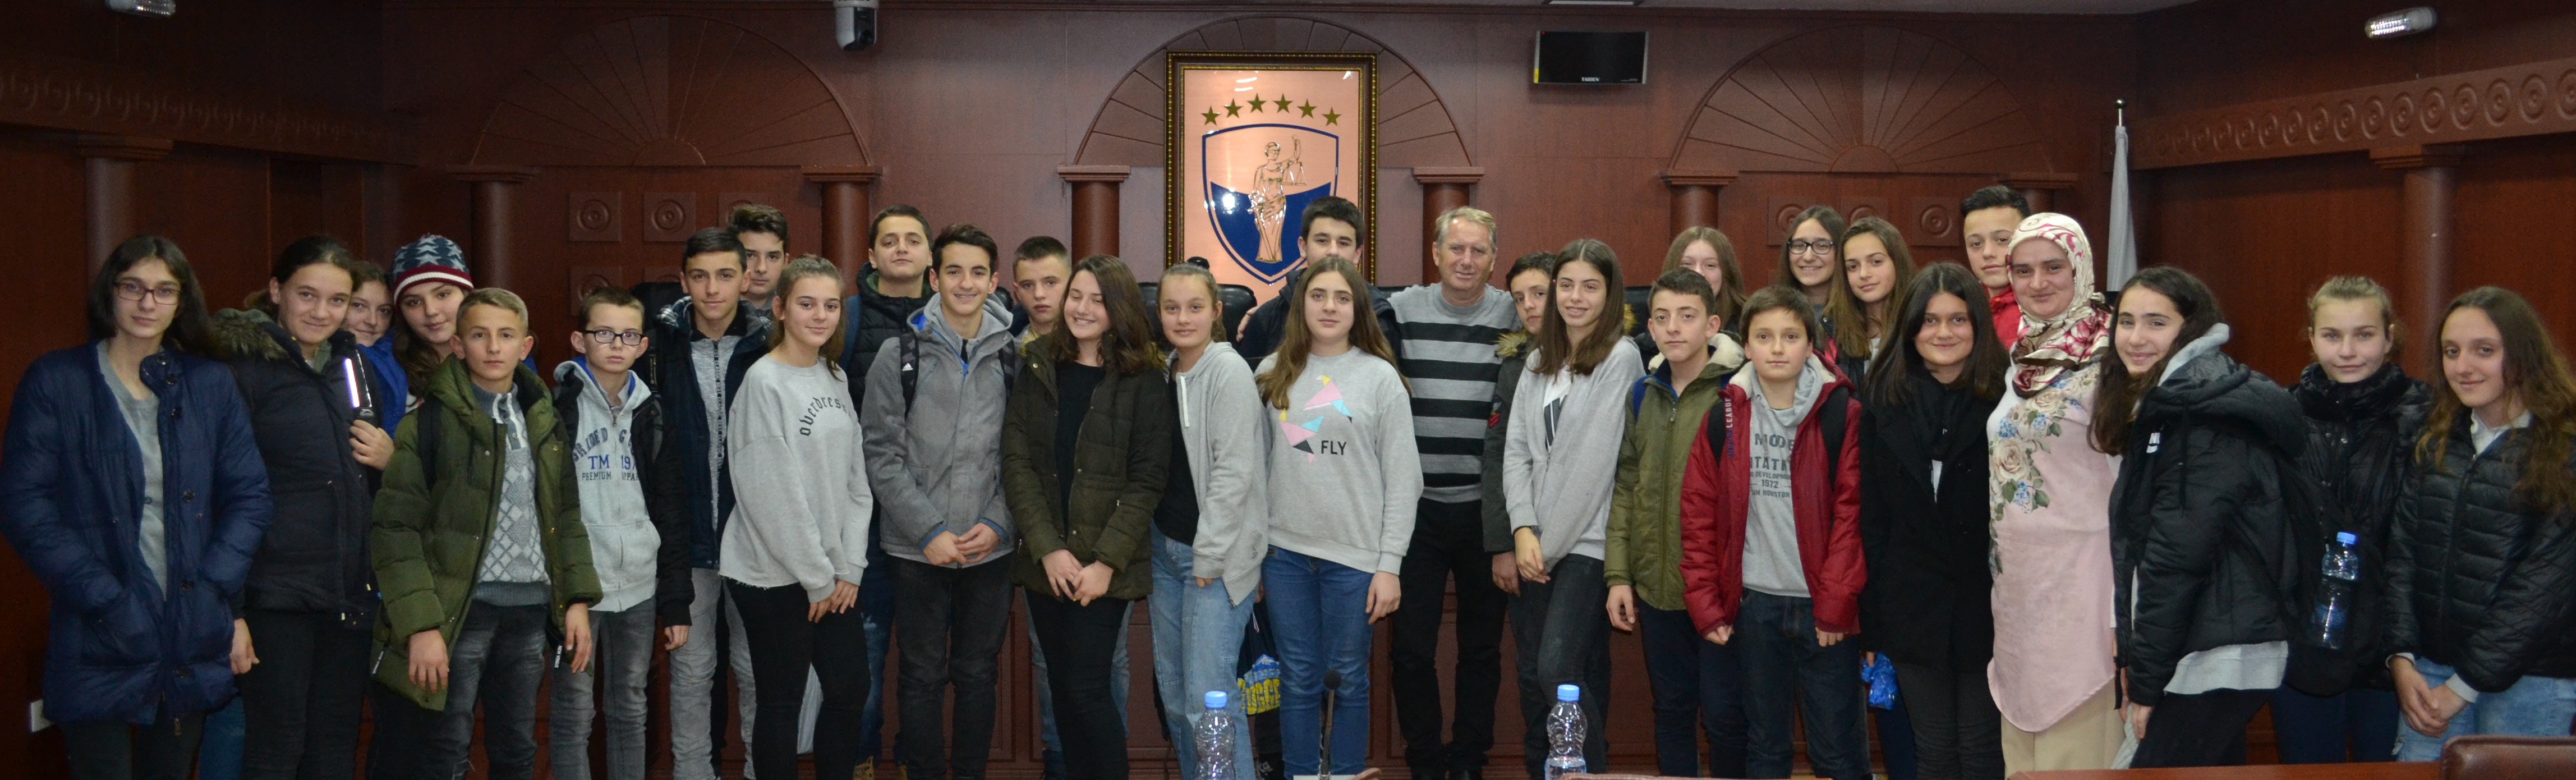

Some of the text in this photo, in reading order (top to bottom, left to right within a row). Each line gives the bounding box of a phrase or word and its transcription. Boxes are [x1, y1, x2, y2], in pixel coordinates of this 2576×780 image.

[1724, 397, 1733, 428] LEAGUE
[1321, 441, 1347, 456] FLY
[588, 454, 610, 470] TM
[582, 471, 611, 481] PREMIUM
[1761, 479, 1779, 489] 1972
